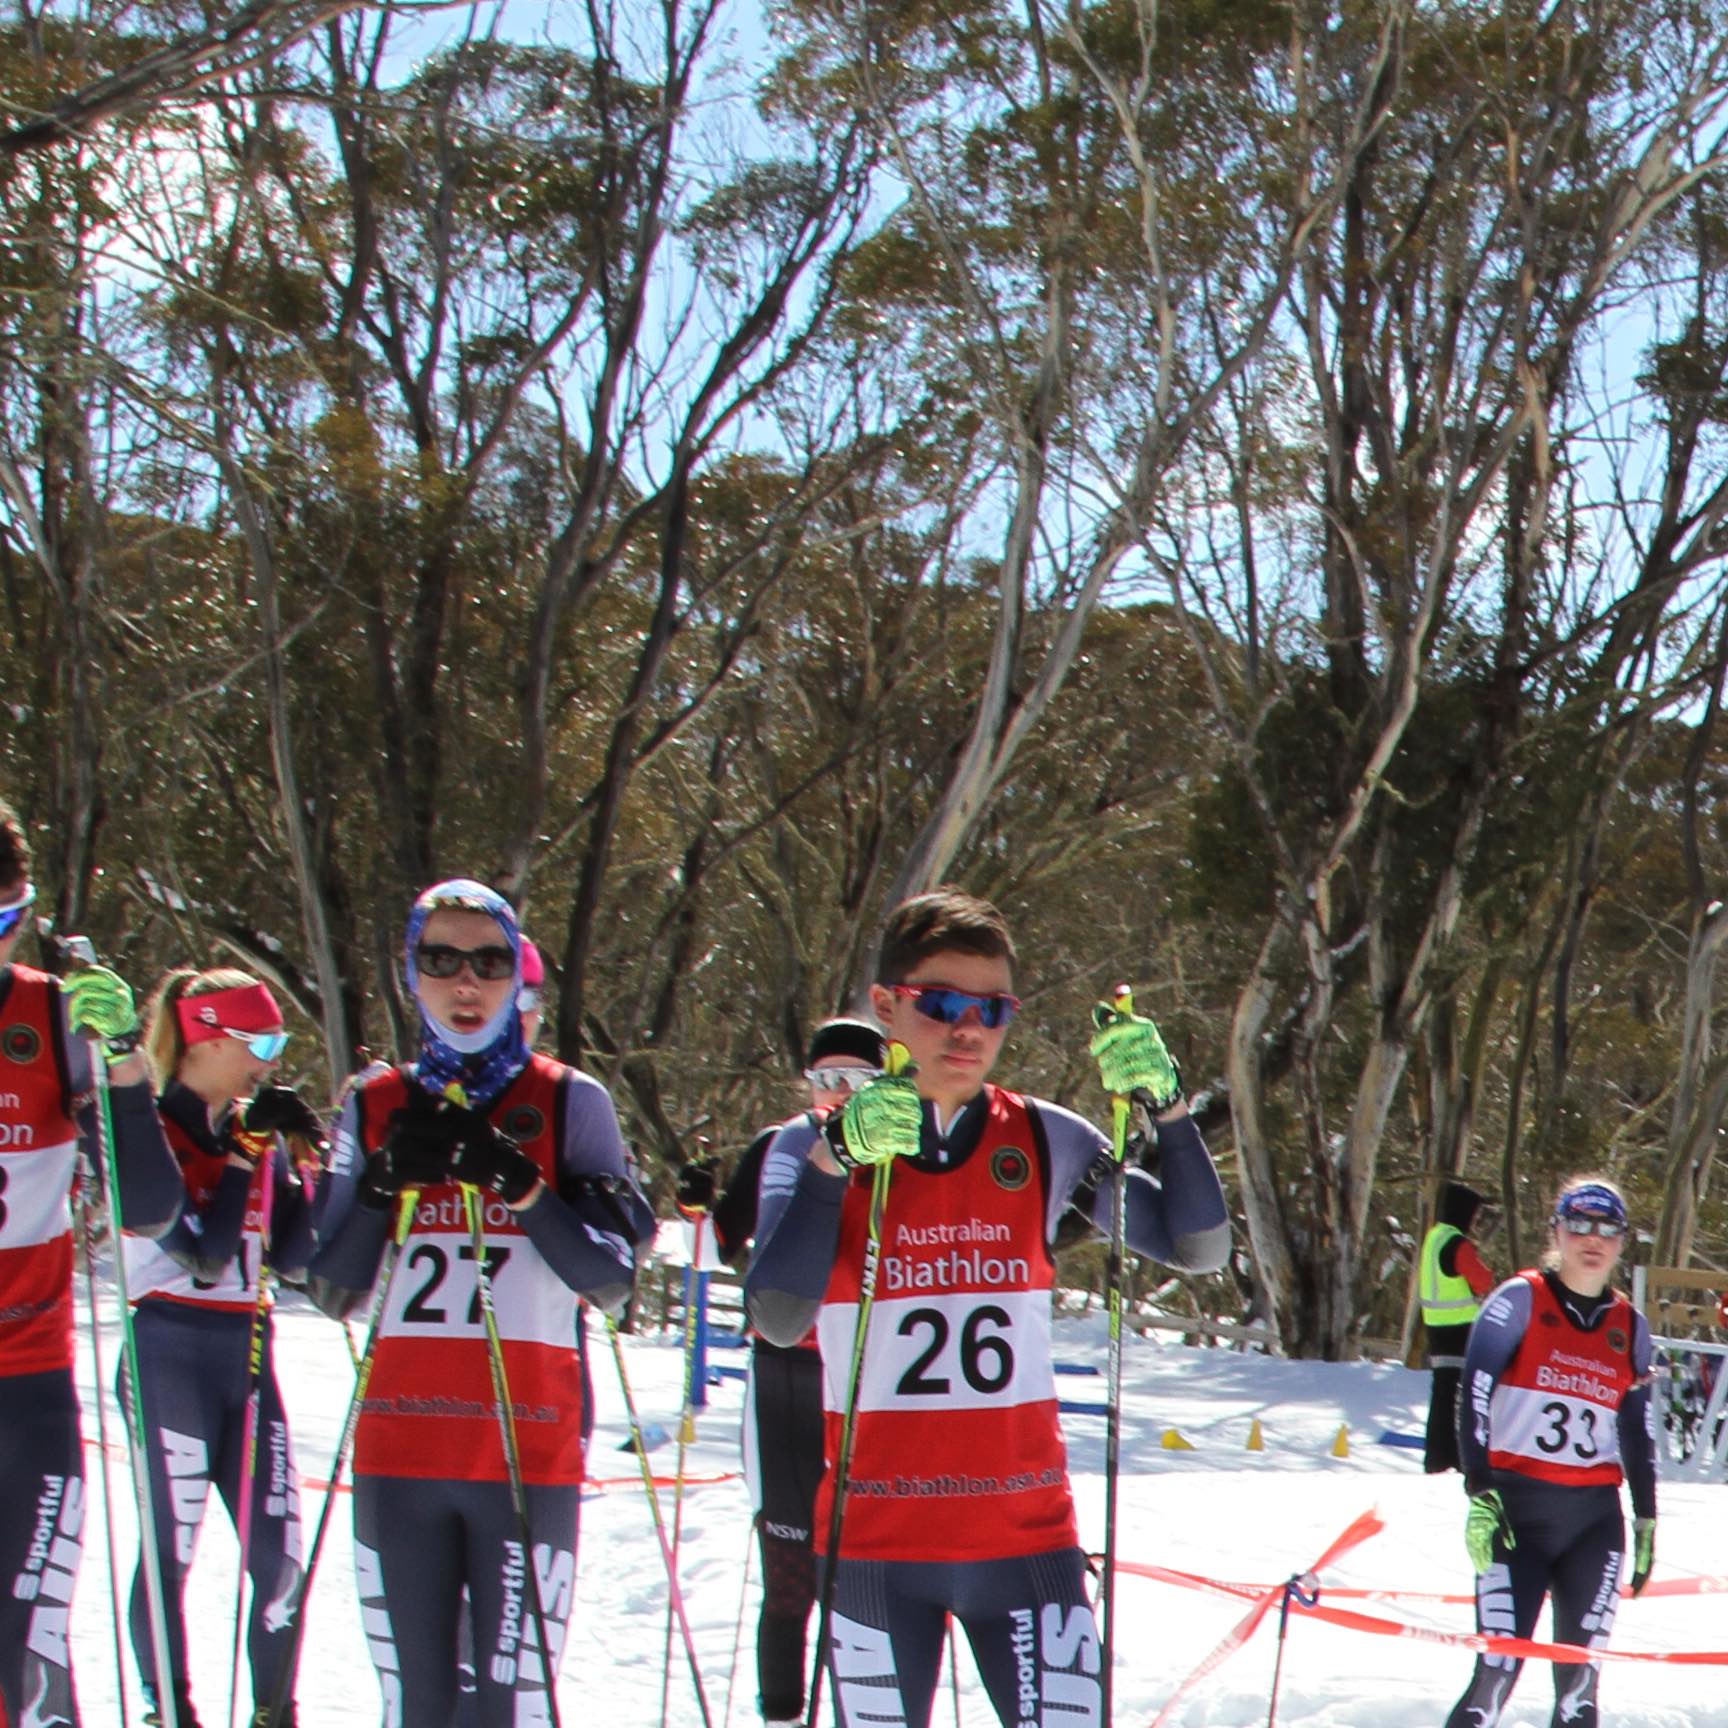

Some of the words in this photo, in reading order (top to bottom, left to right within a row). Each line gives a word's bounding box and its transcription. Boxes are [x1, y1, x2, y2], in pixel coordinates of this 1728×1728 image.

[413, 1193, 519, 1227] athlo
[896, 1218, 1012, 1248] Australian
[401, 1243, 511, 1325] 27
[884, 1250, 1030, 1291] Biathlon
[895, 1304, 1016, 1396] 26
[1550, 1348, 1618, 1380] Australian
[1536, 1364, 1620, 1404] Biathlon
[1535, 1401, 1599, 1460] 33
[764, 1519, 810, 1545] NSW
[499, 1540, 526, 1656] sportful
[1009, 1607, 1039, 1719] sportful
